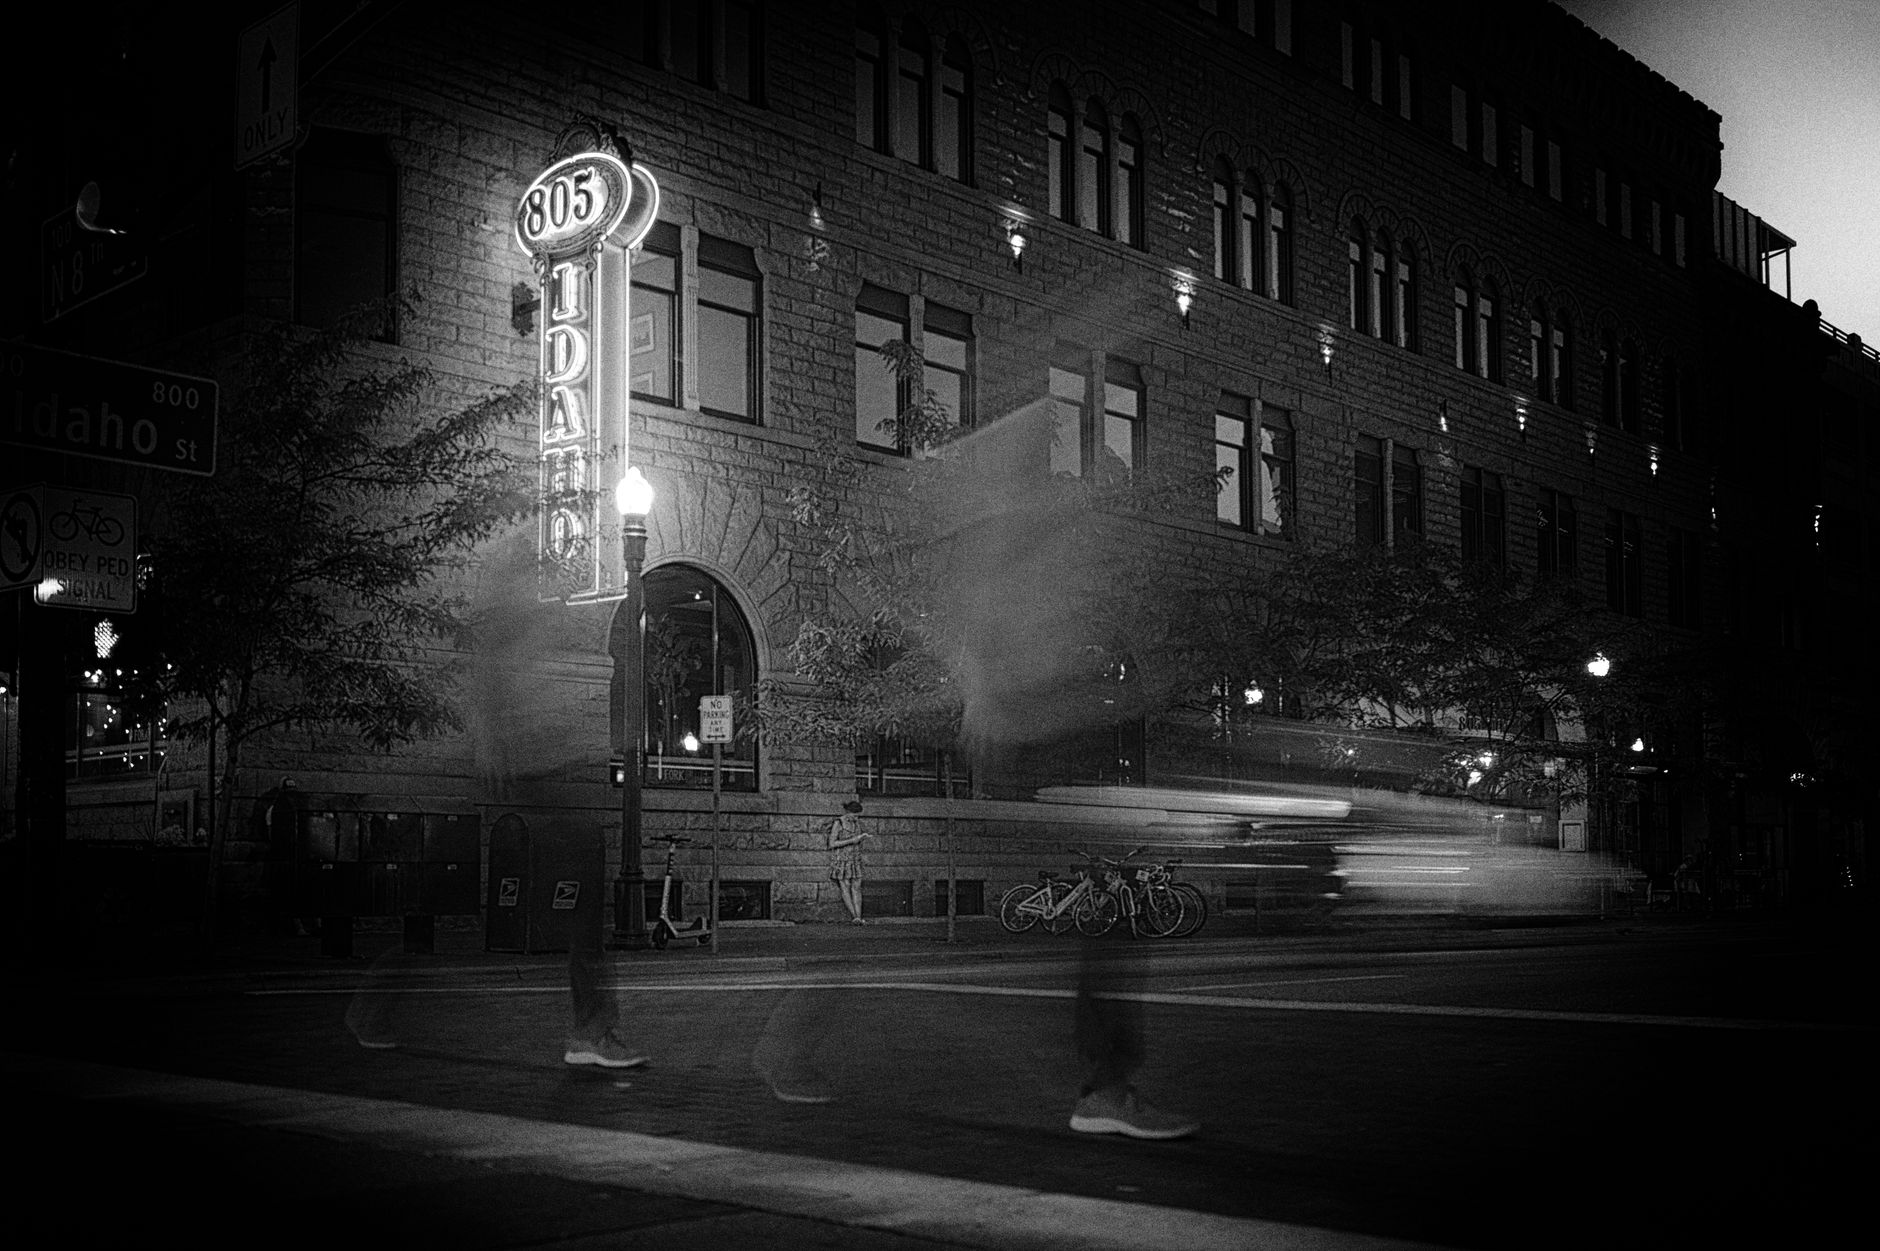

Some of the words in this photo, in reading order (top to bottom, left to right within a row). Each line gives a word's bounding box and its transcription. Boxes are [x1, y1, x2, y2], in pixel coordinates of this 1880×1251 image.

[244, 106, 288, 151] ONLY
[524, 166, 597, 241] 805
[51, 258, 64, 308] N
[152, 381, 200, 410] 800
[15, 389, 159, 455] Idaho
[44, 550, 88, 572] OBEY
[97, 556, 129, 576] PED
[703, 710, 730, 719] PARKING
[710, 700, 722, 708] NO
[663, 769, 685, 781] FORK
